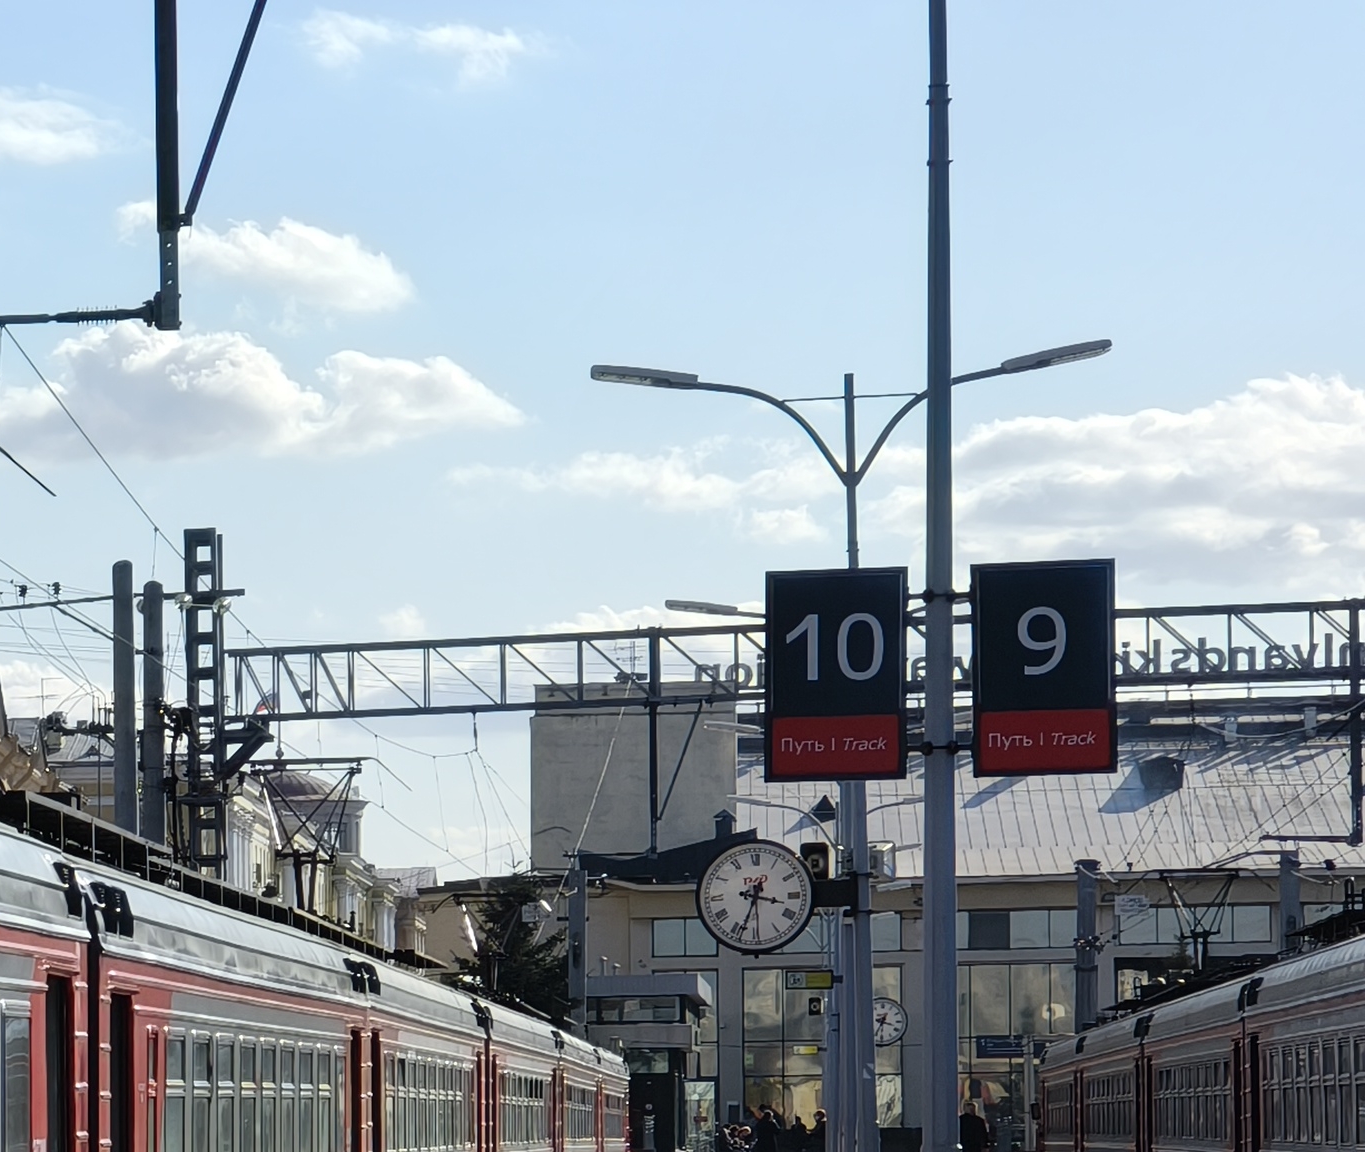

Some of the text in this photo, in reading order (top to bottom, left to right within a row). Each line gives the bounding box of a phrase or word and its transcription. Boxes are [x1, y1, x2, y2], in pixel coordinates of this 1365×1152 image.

[786, 612, 884, 681] 10
[1018, 606, 1067, 675] 9
[781, 737, 825, 755] Путь
[843, 737, 887, 751] Track
[989, 732, 1033, 751] Путь
[1051, 731, 1096, 746] Track
